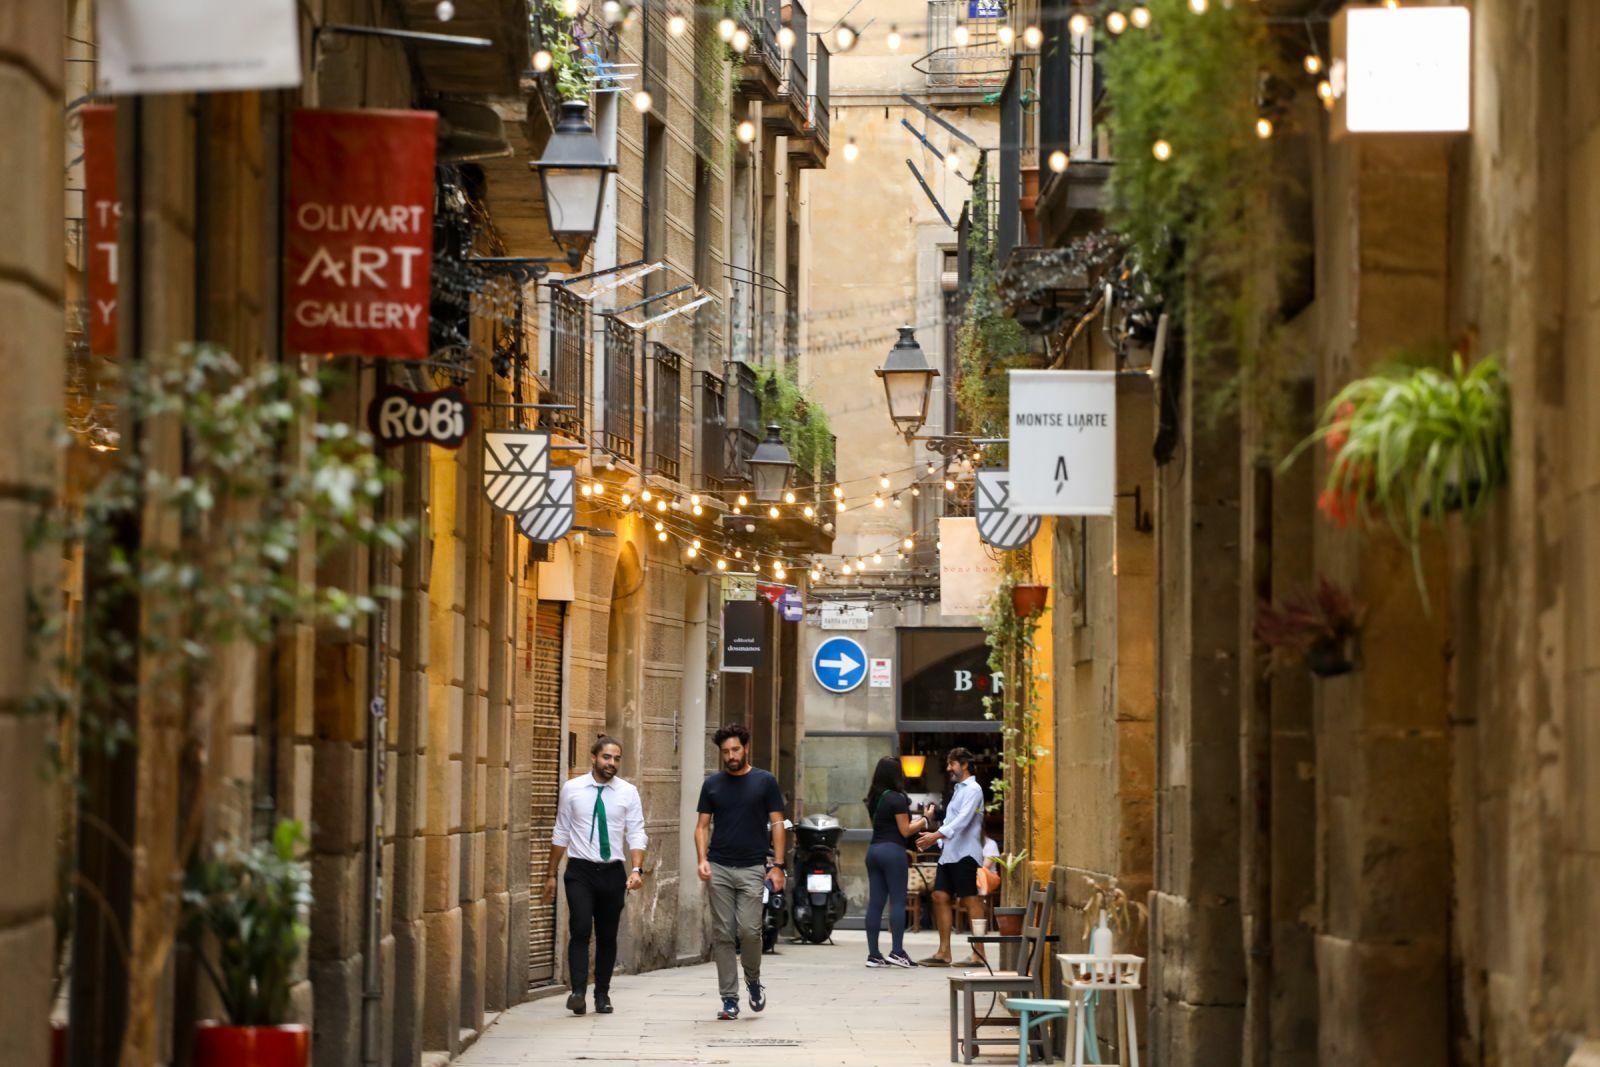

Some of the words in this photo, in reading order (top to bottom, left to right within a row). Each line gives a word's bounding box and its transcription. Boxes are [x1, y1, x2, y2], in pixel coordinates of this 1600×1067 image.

[297, 202, 425, 233] OLIVART
[297, 245, 424, 289] ART
[296, 300, 423, 330] GALLERY
[1016, 413, 1063, 427] MONTSE
[1067, 413, 1108, 431] LIARTE
[727, 644, 761, 652] dosmanos
